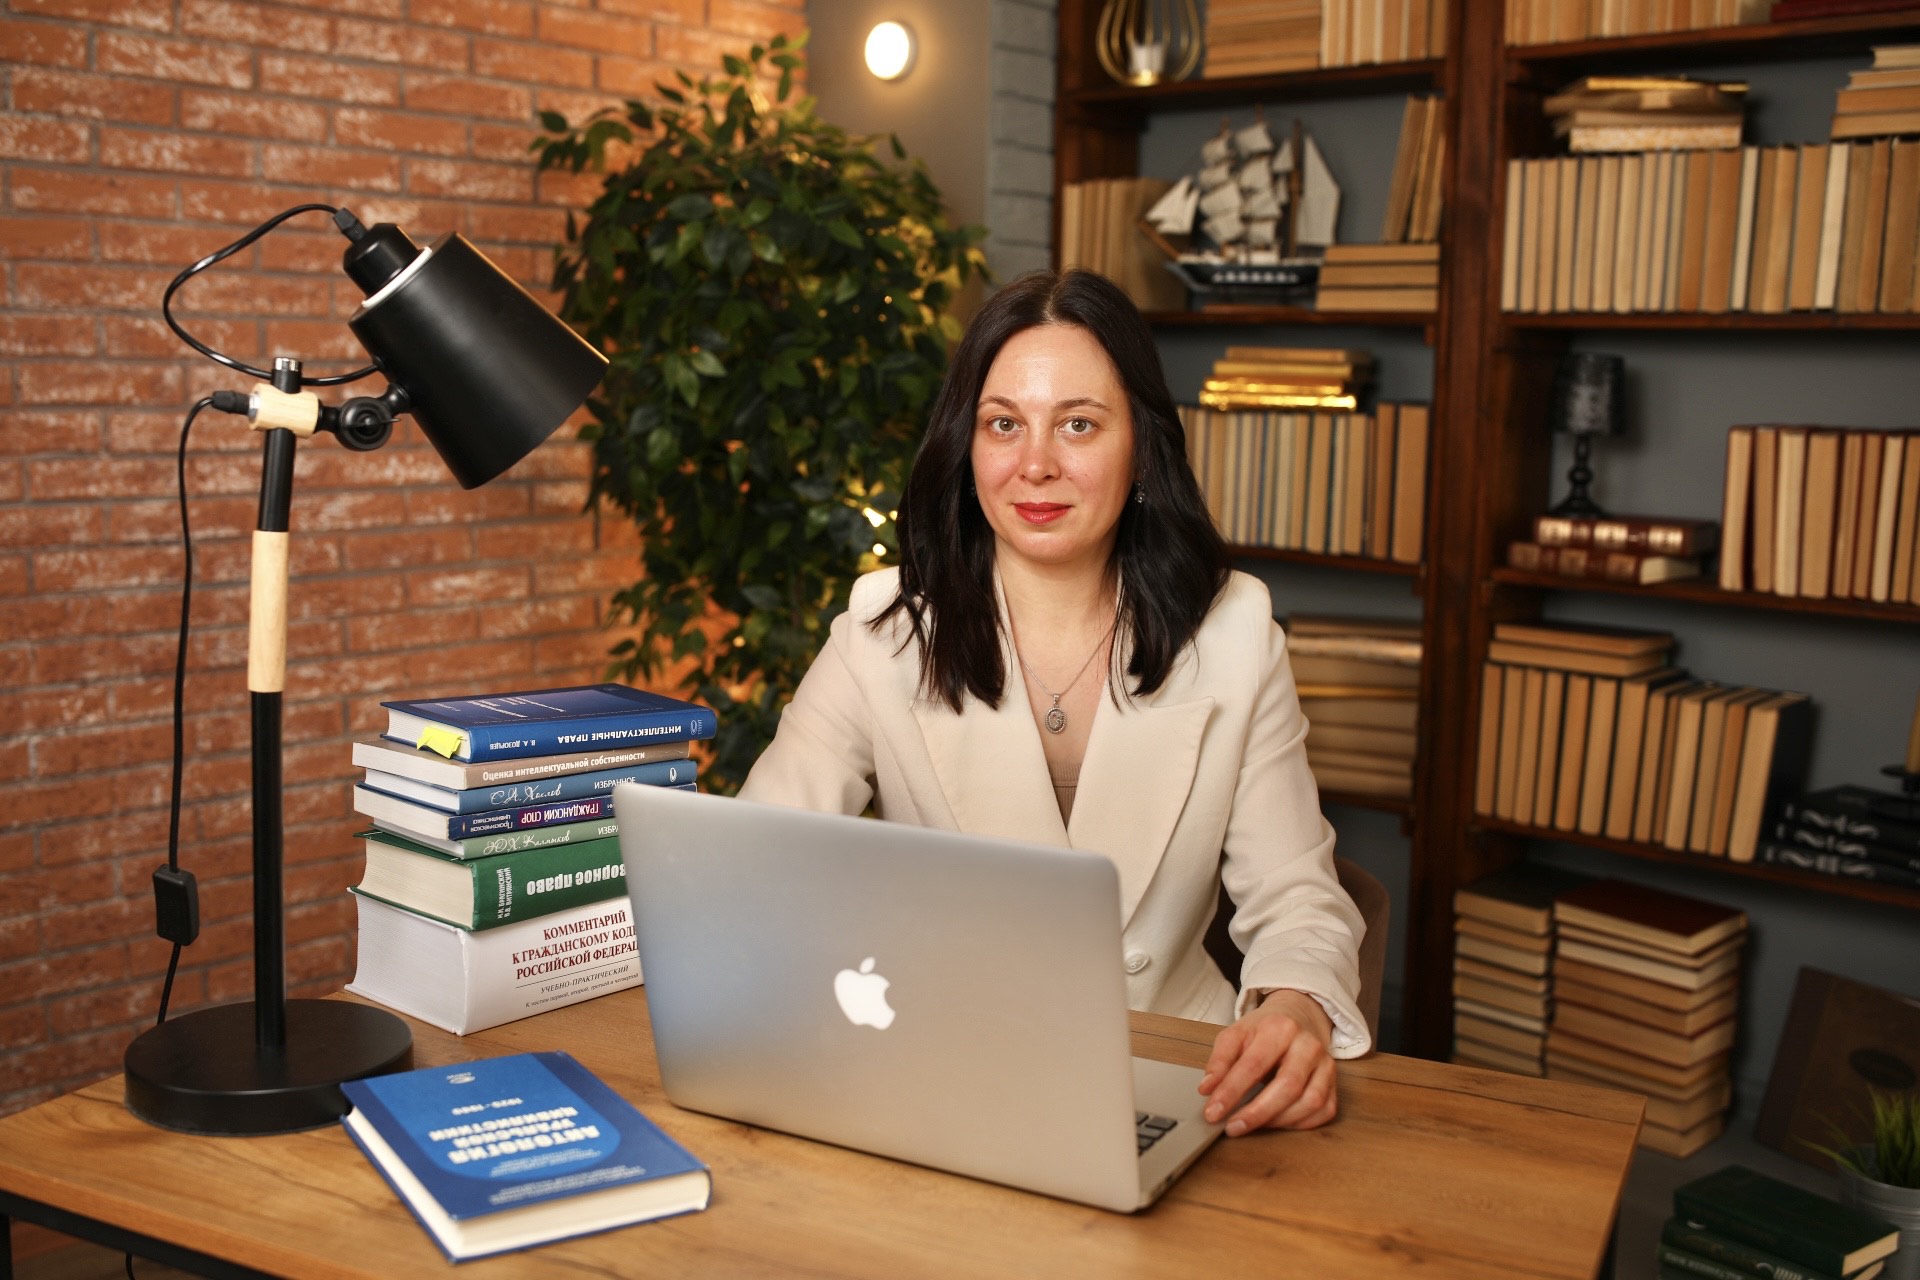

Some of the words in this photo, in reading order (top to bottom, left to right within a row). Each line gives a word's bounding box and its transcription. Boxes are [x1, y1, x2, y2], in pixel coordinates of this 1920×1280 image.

[557, 735, 589, 744] ПРАВА
[591, 725, 682, 741] ИНТЕЛЛЕКТУАЛЬНЫЕ
[482, 770, 513, 781] Оценка
[515, 758, 589, 777] интеллектуальной
[590, 751, 645, 768] собственности
[594, 776, 636, 790] ИЗБРАННОЕ
[521, 811, 542, 824] СПОР
[544, 802, 599, 822] ГРАЖДАНСКИЙ
[526, 874, 573, 896] право
[543, 910, 627, 941] КОММЕНТАРИЙ
[512, 953, 520, 964] К
[522, 931, 611, 962] ГРАЖДАНСКОМУ
[516, 950, 592, 980] РОССИЙСКОЙ
[541, 965, 629, 994] УЧЕБНО-ПРАКТИЧЕСКИЙ
[447, 1124, 601, 1165] АНТОЛОГИЯ
